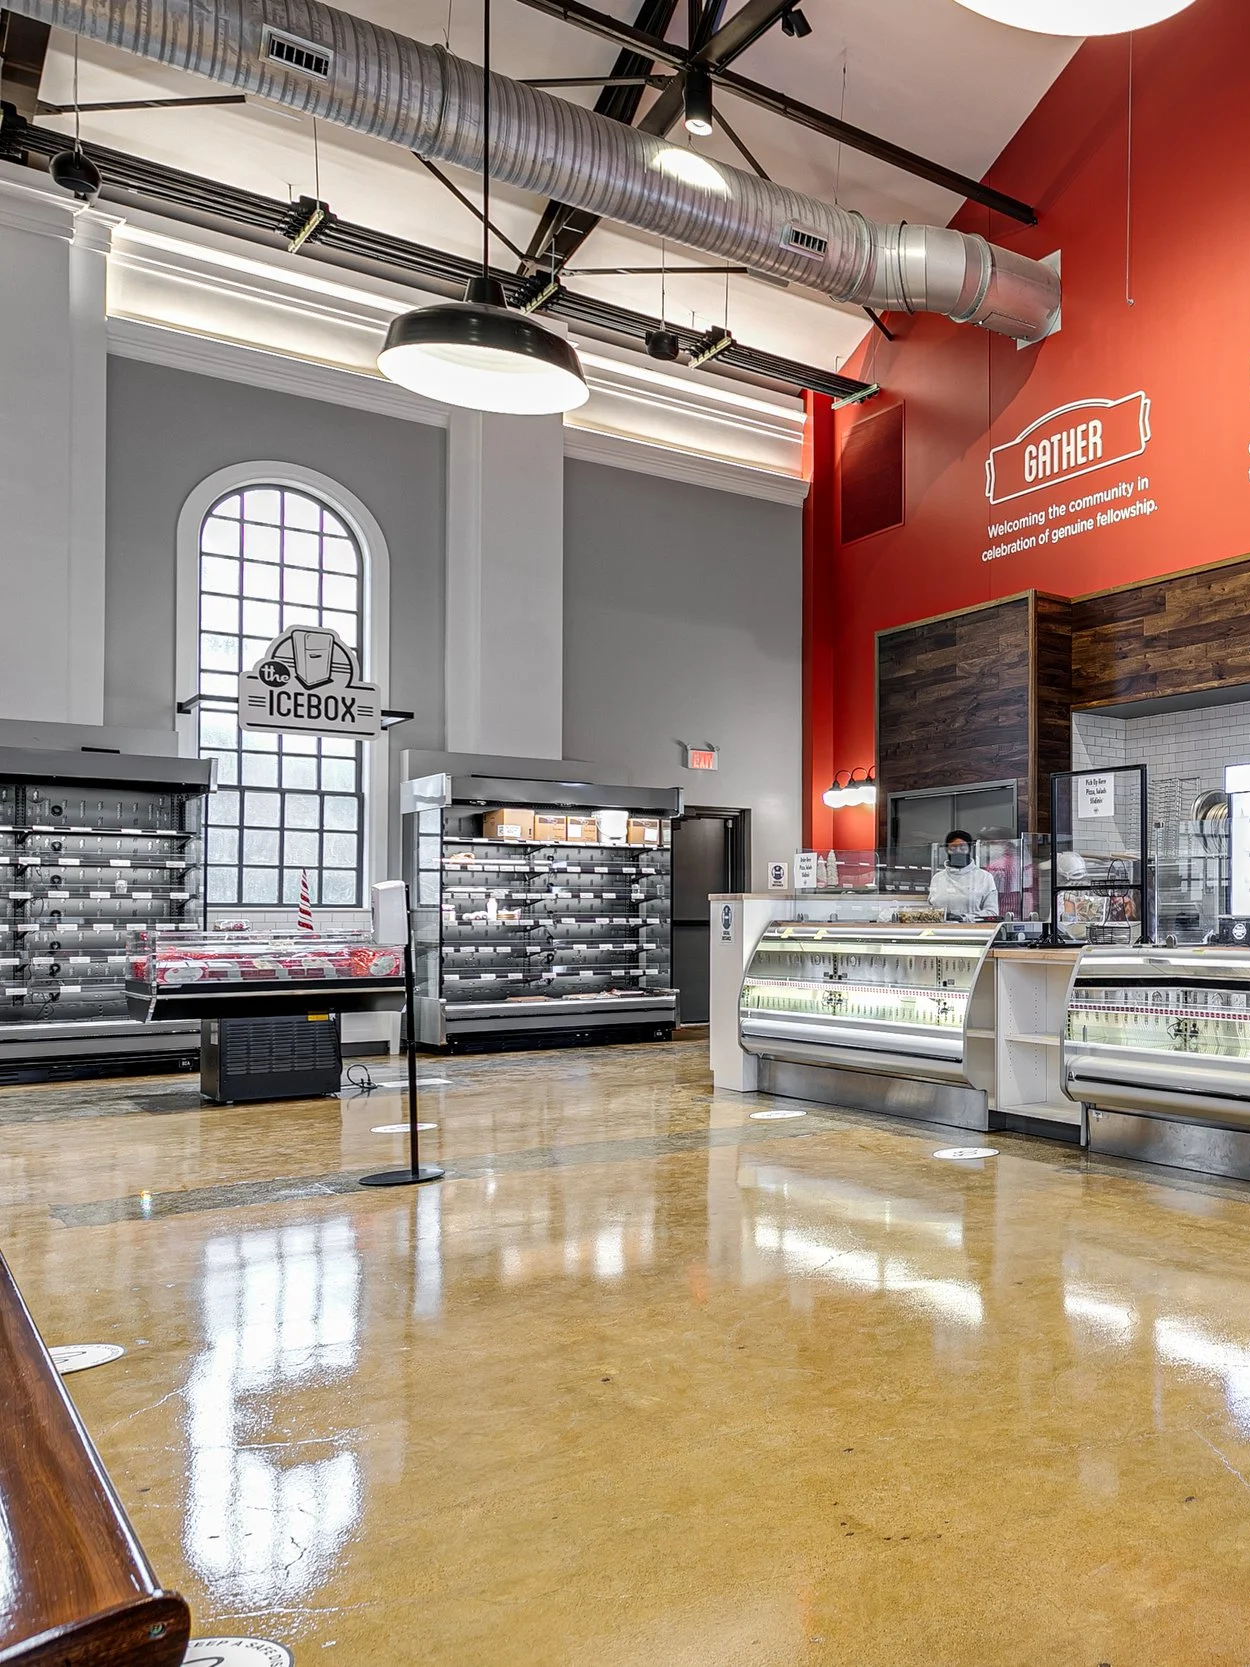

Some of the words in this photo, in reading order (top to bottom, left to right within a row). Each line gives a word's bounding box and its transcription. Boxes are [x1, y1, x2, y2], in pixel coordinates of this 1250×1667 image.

[1024, 419, 1102, 482] GATHER
[981, 532, 1036, 562] celebration
[1038, 529, 1050, 545] of
[1051, 518, 1094, 544] genuine
[1096, 498, 1158, 527] fellowship.
[988, 511, 1046, 538] Welcoming
[1048, 503, 1066, 519] the
[1069, 482, 1134, 512] community
[1137, 476, 1149, 491] in
[261, 665, 290, 683] the
[269, 690, 356, 723] ICEBOX
[691, 751, 713, 769] EXIT
